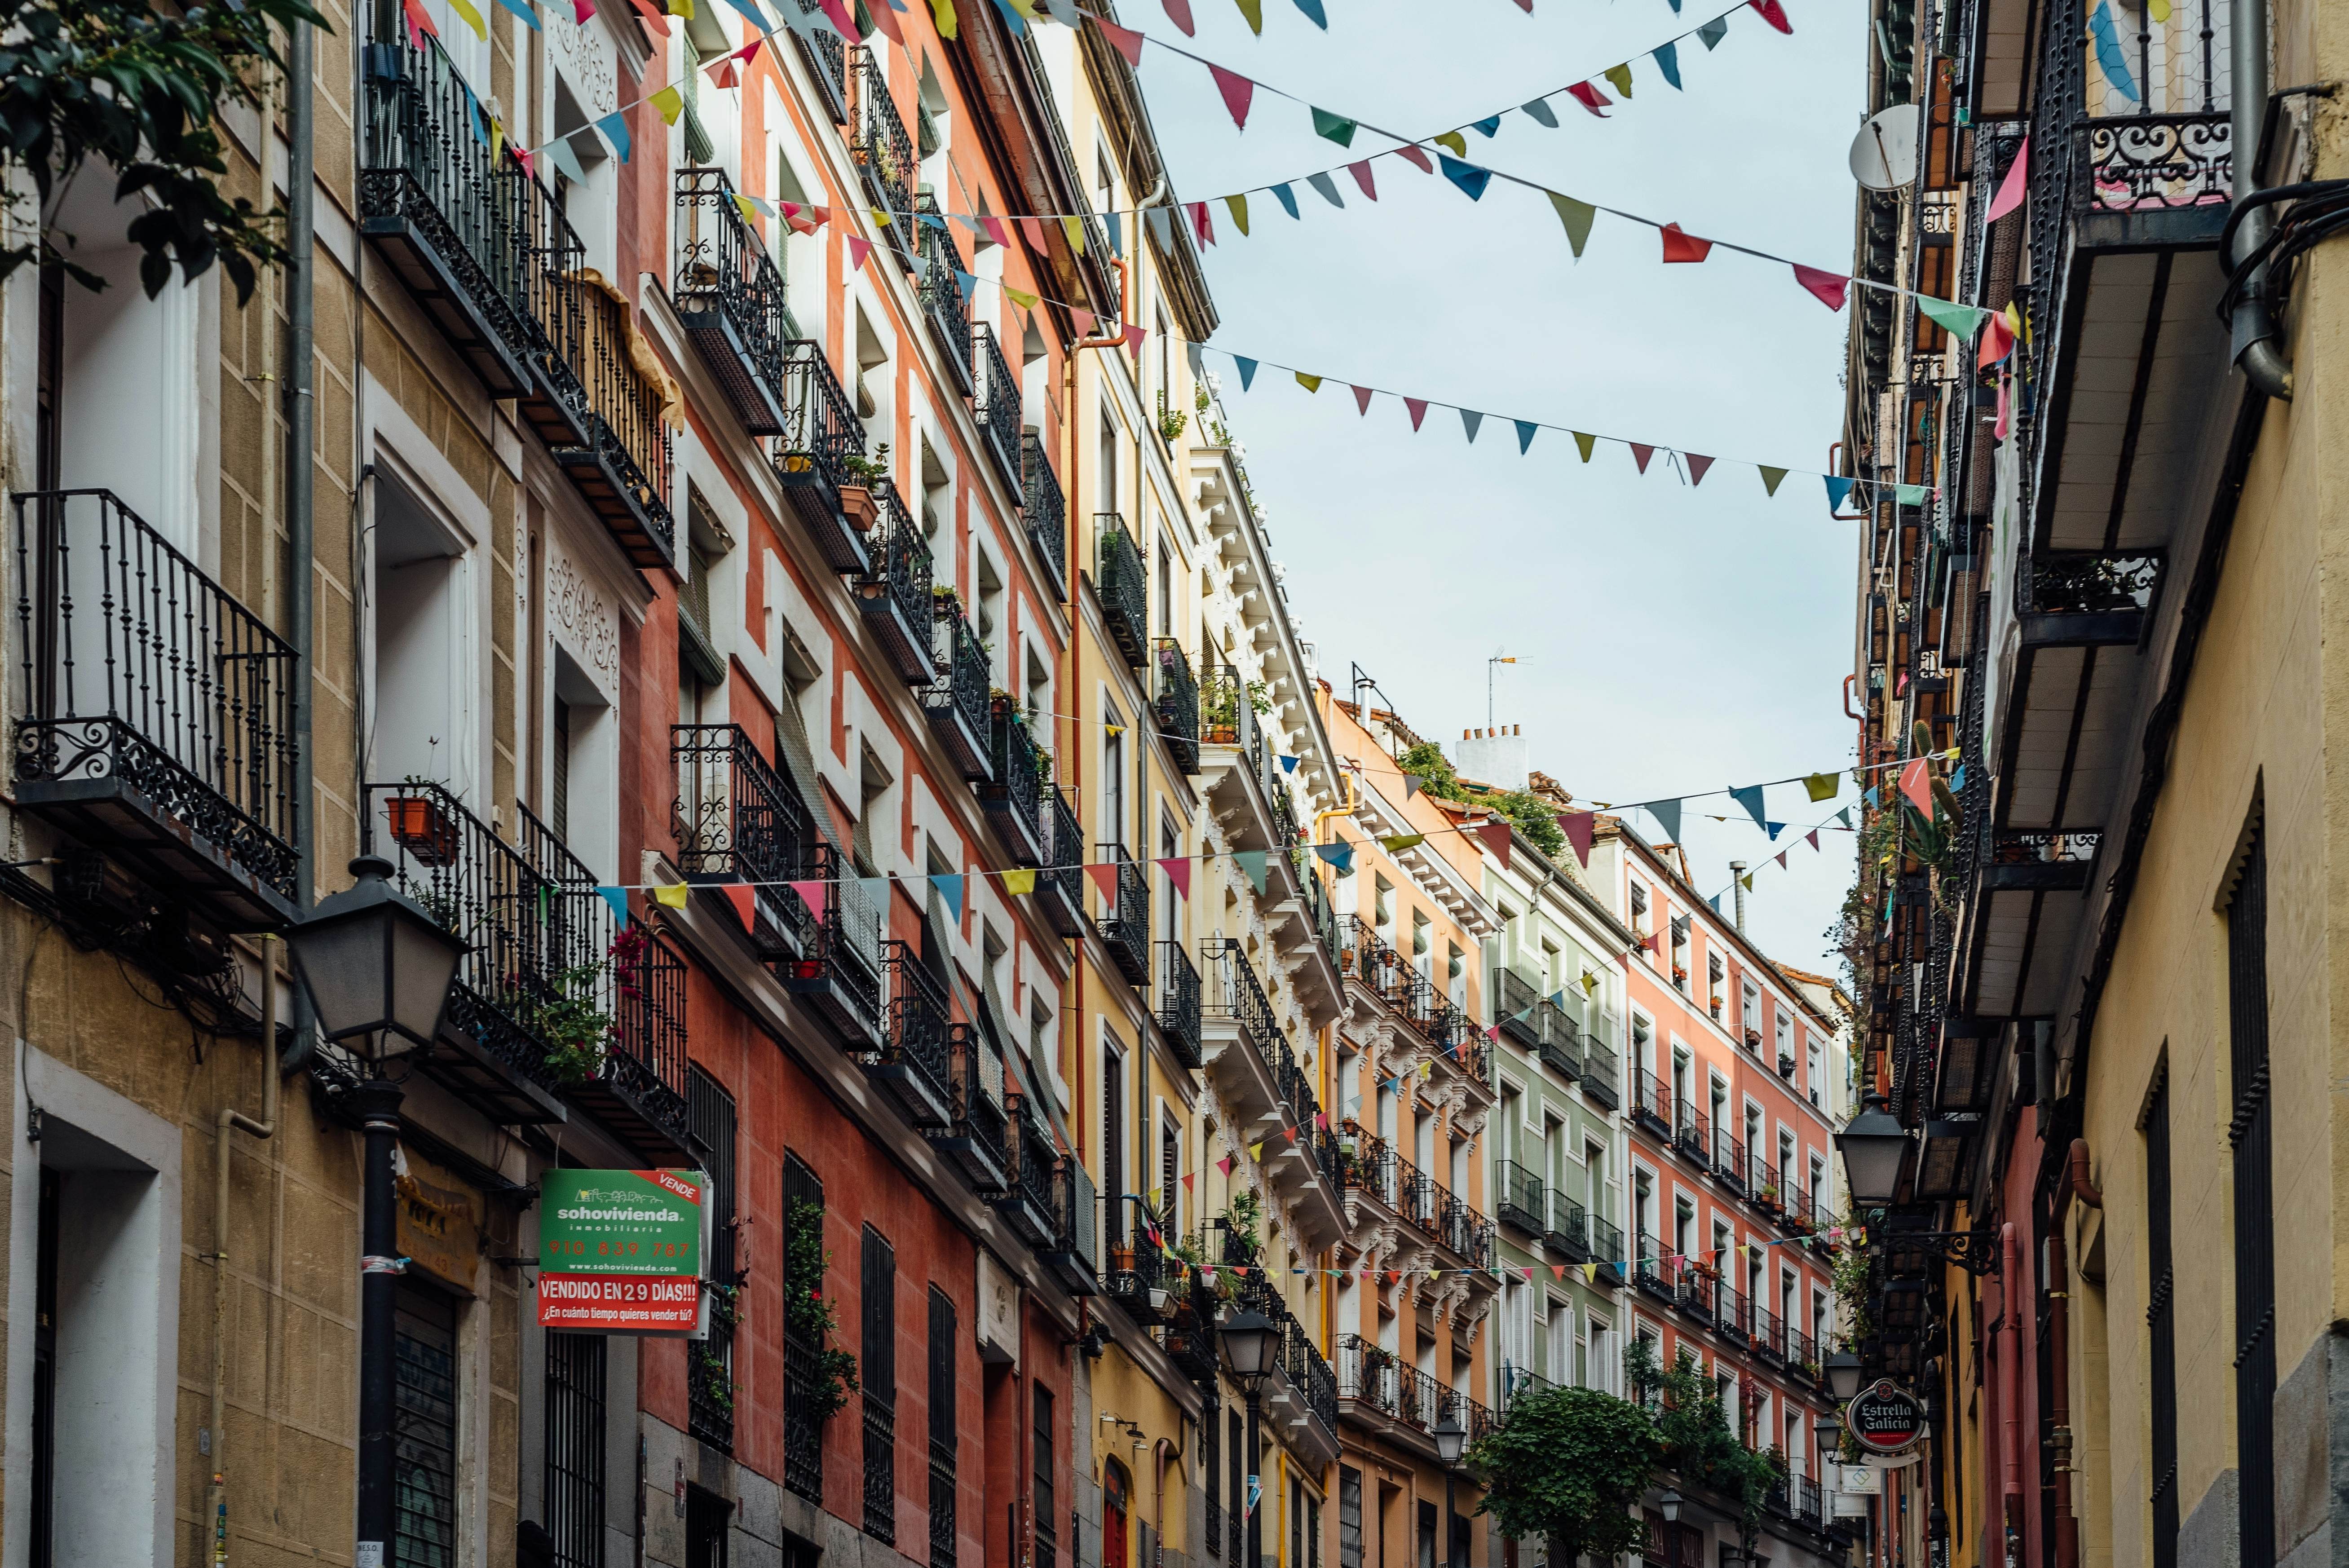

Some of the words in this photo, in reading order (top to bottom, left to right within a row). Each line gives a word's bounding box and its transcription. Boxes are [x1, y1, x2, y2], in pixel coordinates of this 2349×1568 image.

[659, 1173, 696, 1198] VENDE
[549, 1240, 584, 1254] 910
[598, 1241, 639, 1256] 839
[653, 1243, 689, 1257] 787
[569, 1263, 677, 1272] www.sohovivienda.com
[541, 1280, 600, 1299] VENDIDO
[604, 1282, 621, 1300] EN
[624, 1284, 648, 1301] 29
[652, 1280, 696, 1302] DÍAS!!!
[544, 1306, 561, 1321] ¿En
[562, 1306, 590, 1319] cuánto
[591, 1307, 618, 1322] tiempo
[619, 1308, 649, 1322] quieres
[651, 1309, 679, 1321] vender
[680, 1309, 693, 1321] tú?
[1861, 1404, 1912, 1416] Estrella
[1864, 1417, 1911, 1430] Galicia
[1646, 1515, 1664, 1555] ASA
